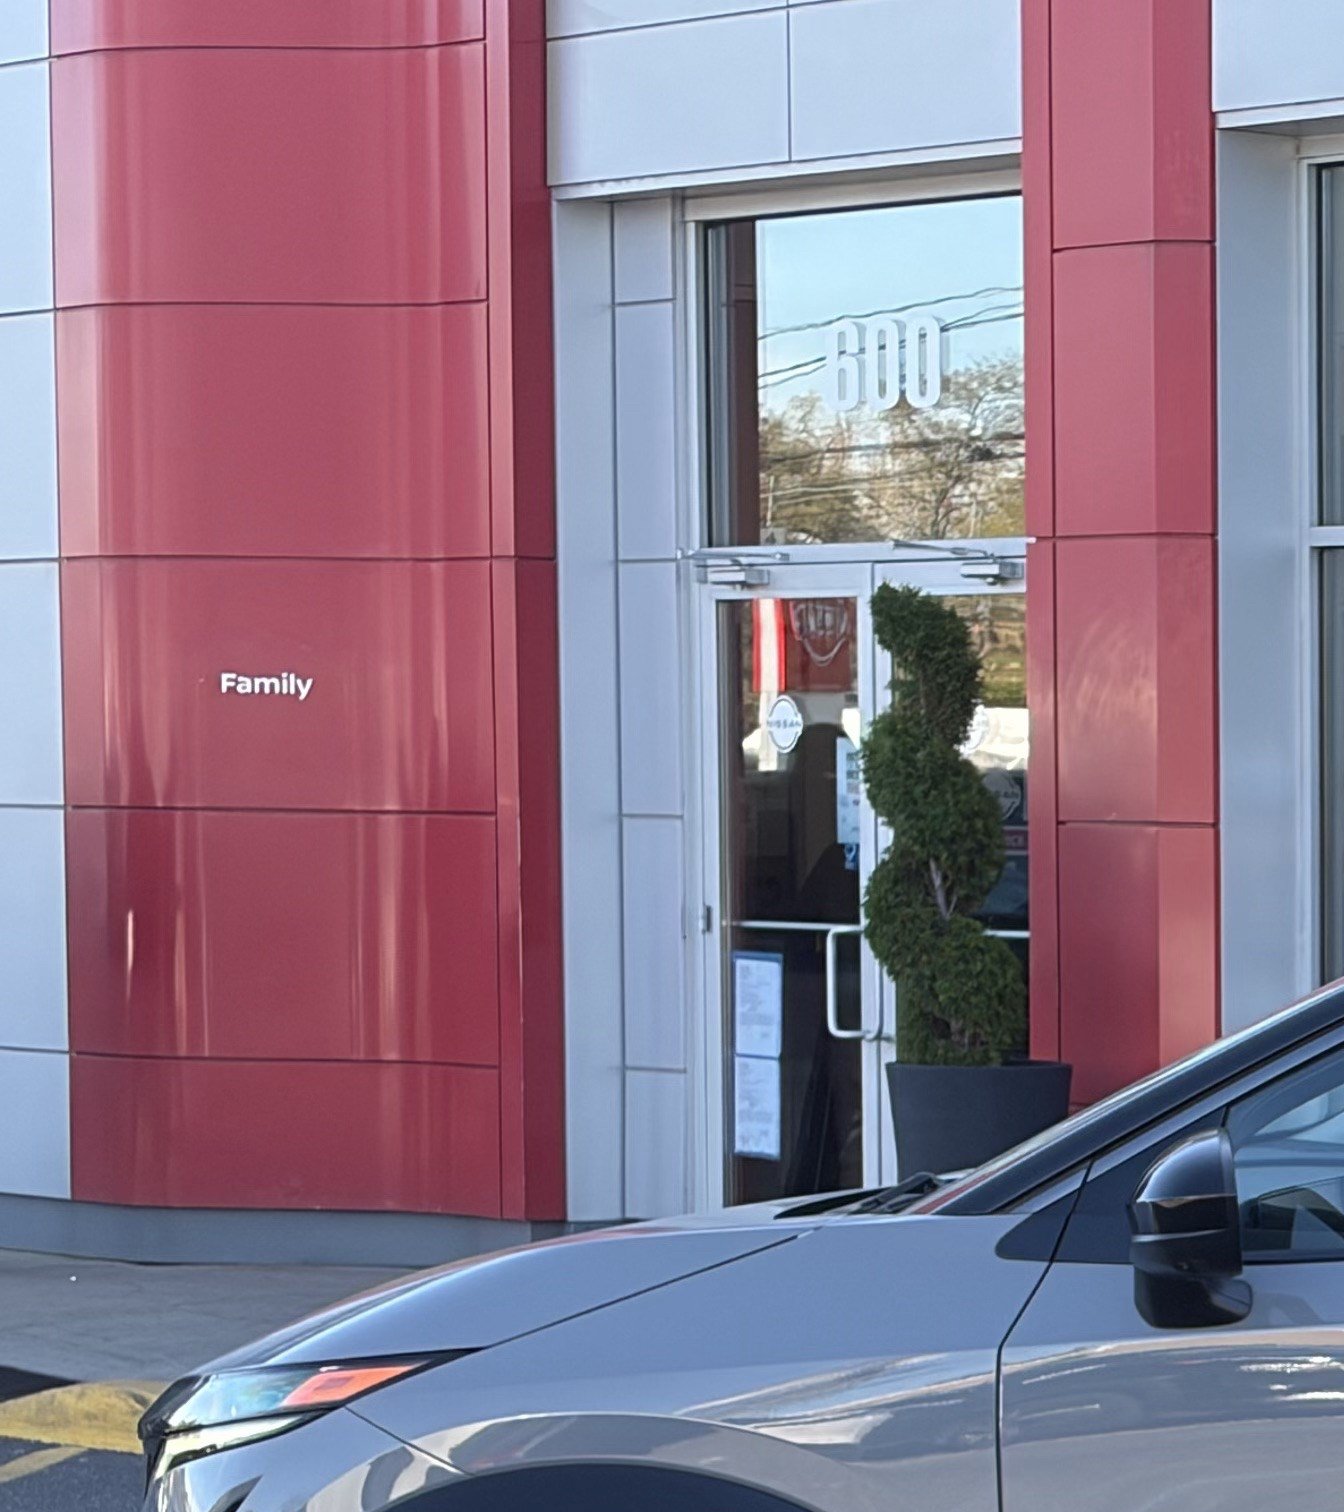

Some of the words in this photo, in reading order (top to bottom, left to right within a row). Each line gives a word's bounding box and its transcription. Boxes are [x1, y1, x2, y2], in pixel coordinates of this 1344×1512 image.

[827, 316, 941, 411] 600
[220, 672, 314, 701] Family
[767, 720, 800, 729] NISSAN
